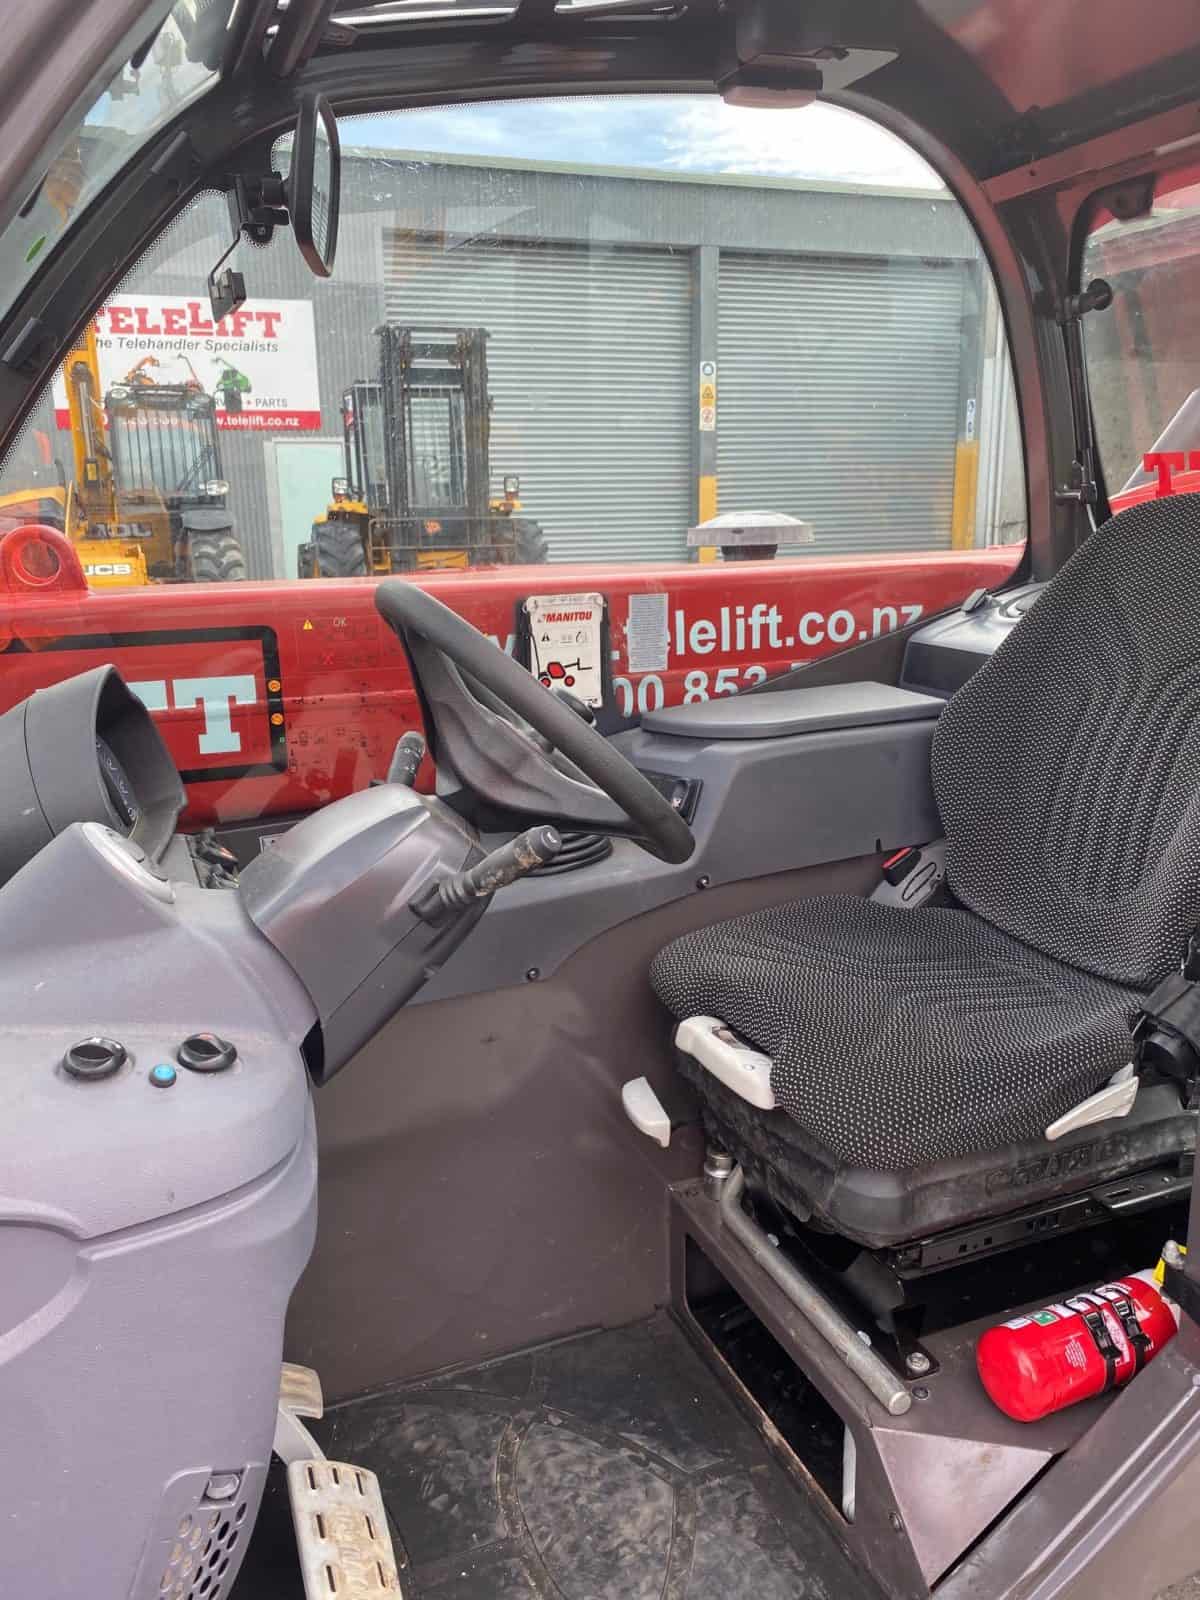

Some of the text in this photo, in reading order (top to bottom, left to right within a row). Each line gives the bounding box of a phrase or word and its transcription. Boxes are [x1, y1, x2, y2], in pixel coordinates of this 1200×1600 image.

[96, 336, 279, 353] he Telehandler Specialists
[256, 399, 288, 408] PARTS
[216, 415, 299, 426] .telelift.co.nz
[84, 563, 131, 576] JCB
[546, 611, 593, 623] MANITOU
